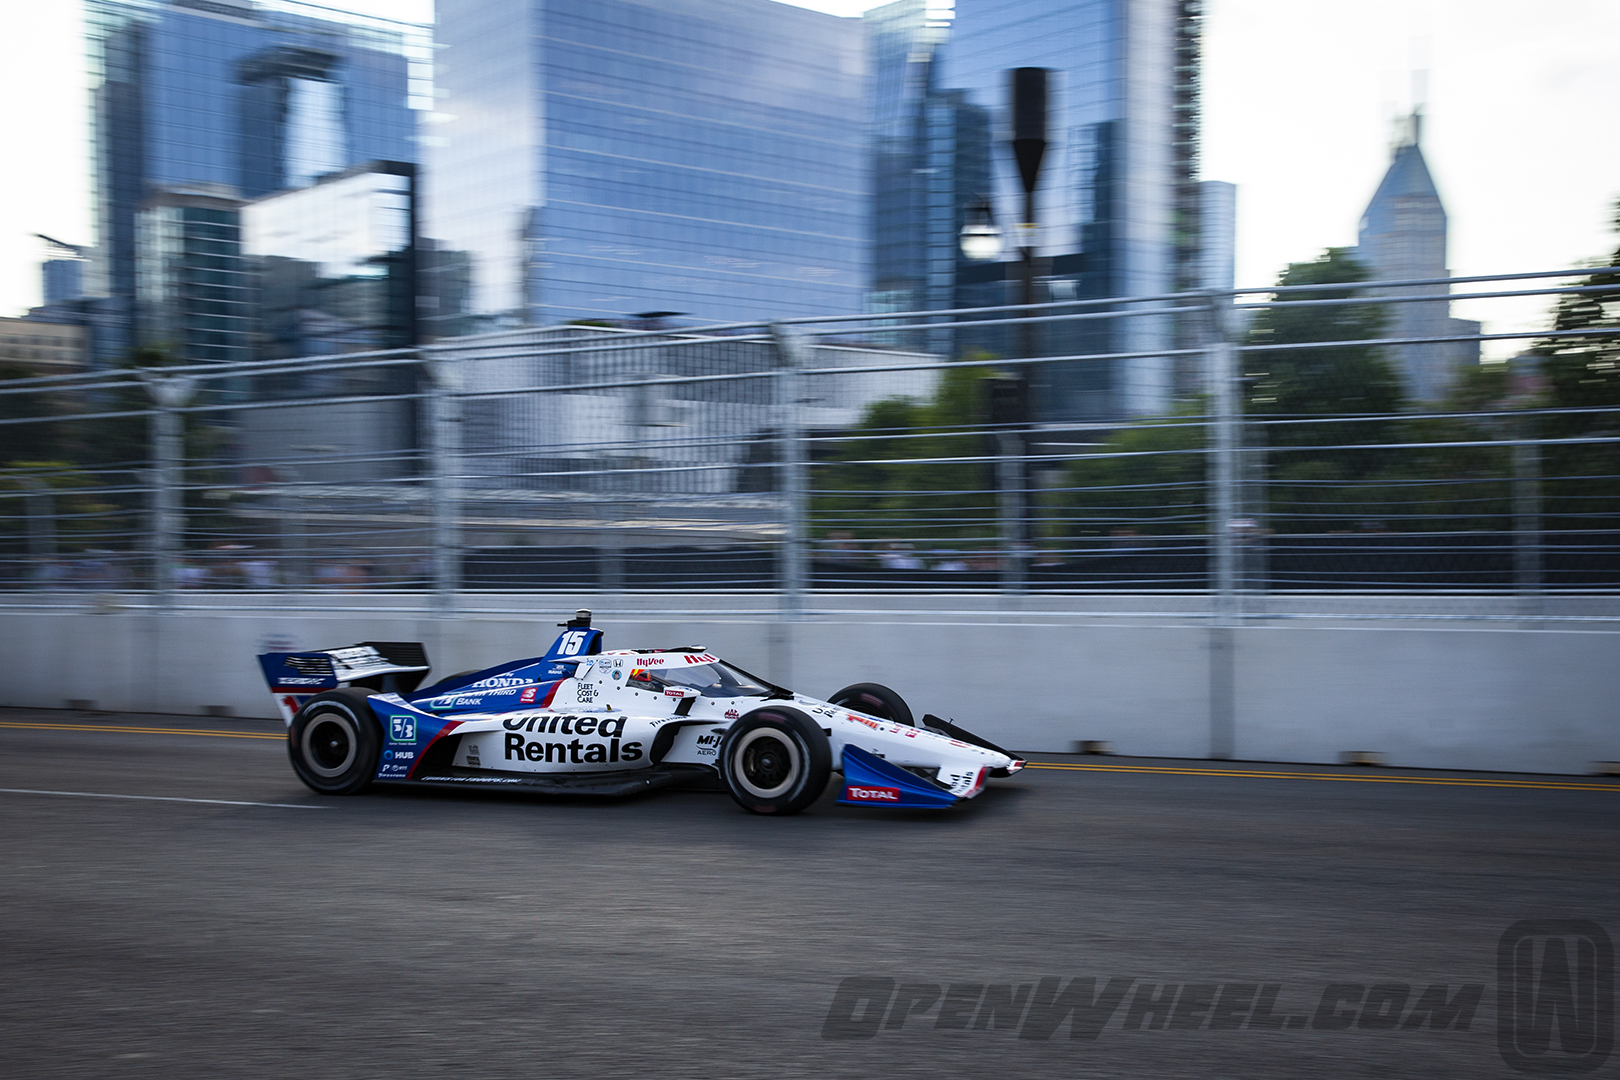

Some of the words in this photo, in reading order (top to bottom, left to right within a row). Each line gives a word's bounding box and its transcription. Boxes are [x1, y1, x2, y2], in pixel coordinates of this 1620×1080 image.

[556, 631, 587, 655] 15
[637, 657, 664, 667] HyVee
[577, 689, 592, 697] COST
[593, 689, 599, 697] &
[455, 698, 482, 706] BANK
[577, 696, 593, 704] CARE
[502, 715, 628, 739] United
[696, 735, 724, 749] MI-J
[504, 732, 643, 764] Rentals
[394, 751, 414, 759] HUB
[849, 787, 899, 800] TOTAL
